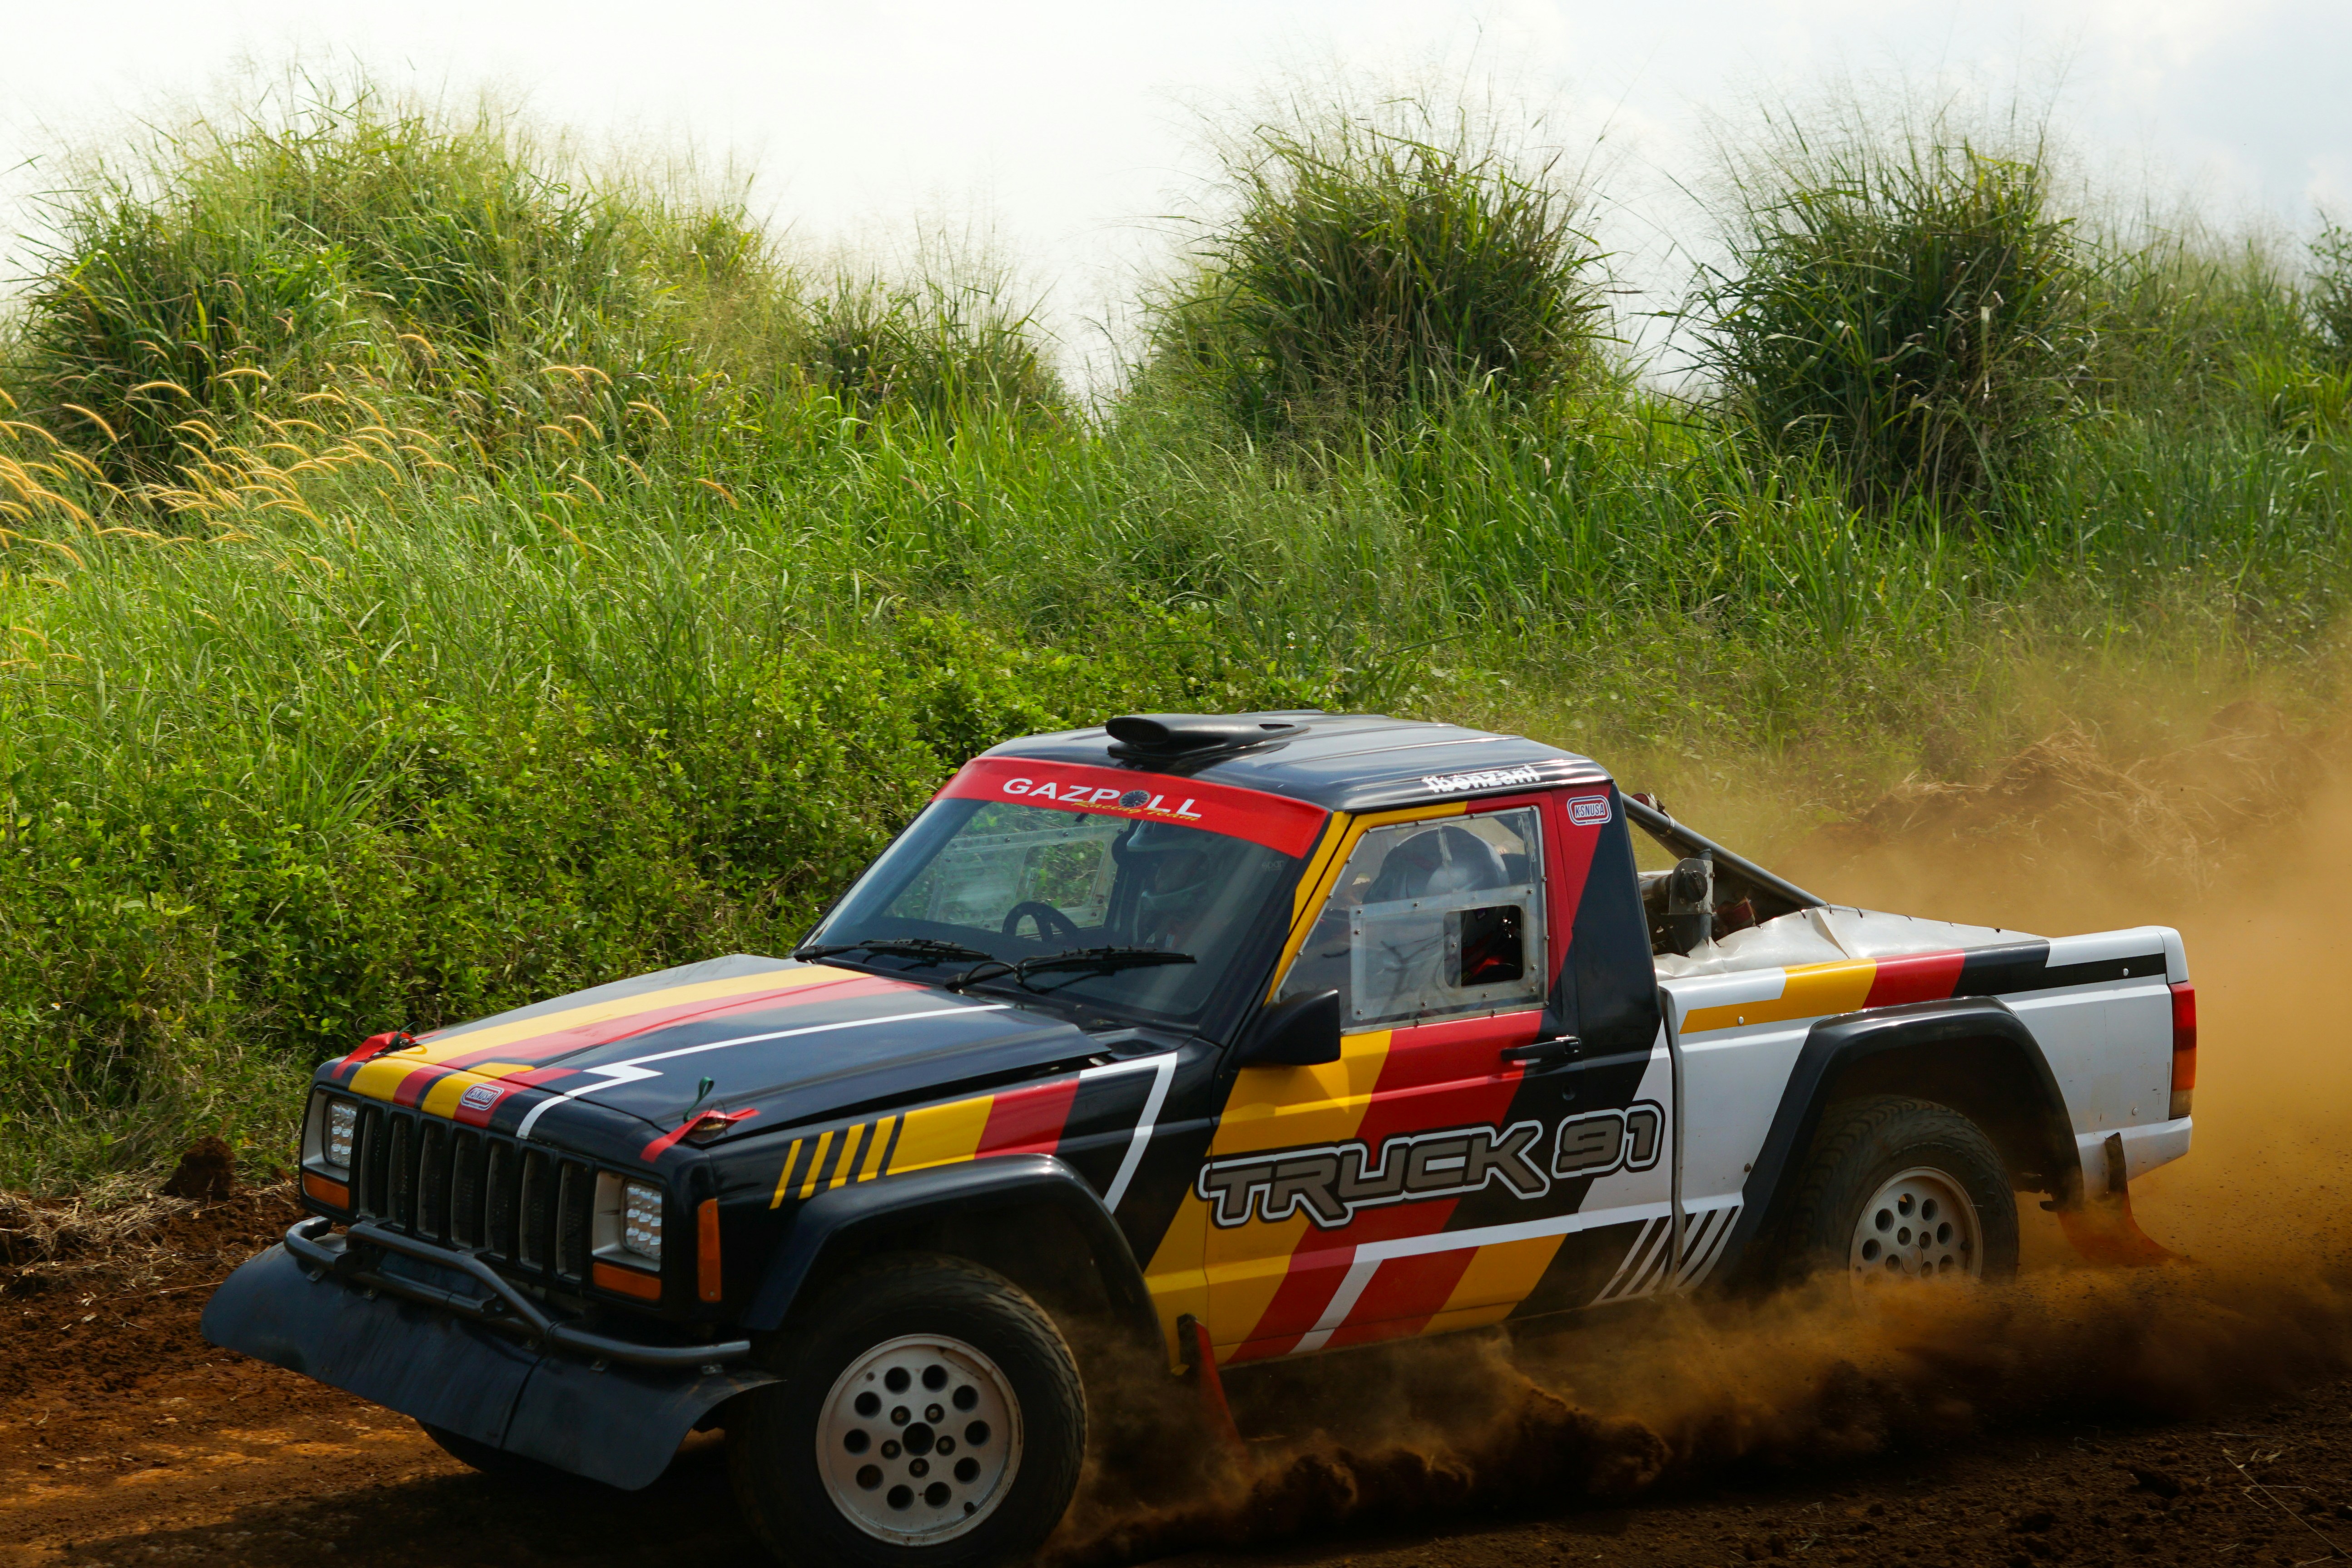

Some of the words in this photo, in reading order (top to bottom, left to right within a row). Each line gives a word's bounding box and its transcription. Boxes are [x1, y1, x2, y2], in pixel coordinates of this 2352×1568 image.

[1071, 800, 1141, 814] Racing
[1144, 808, 1199, 821] Team
[1201, 1120, 1549, 1226] TRUCK
[1552, 1105, 1661, 1178] 91
